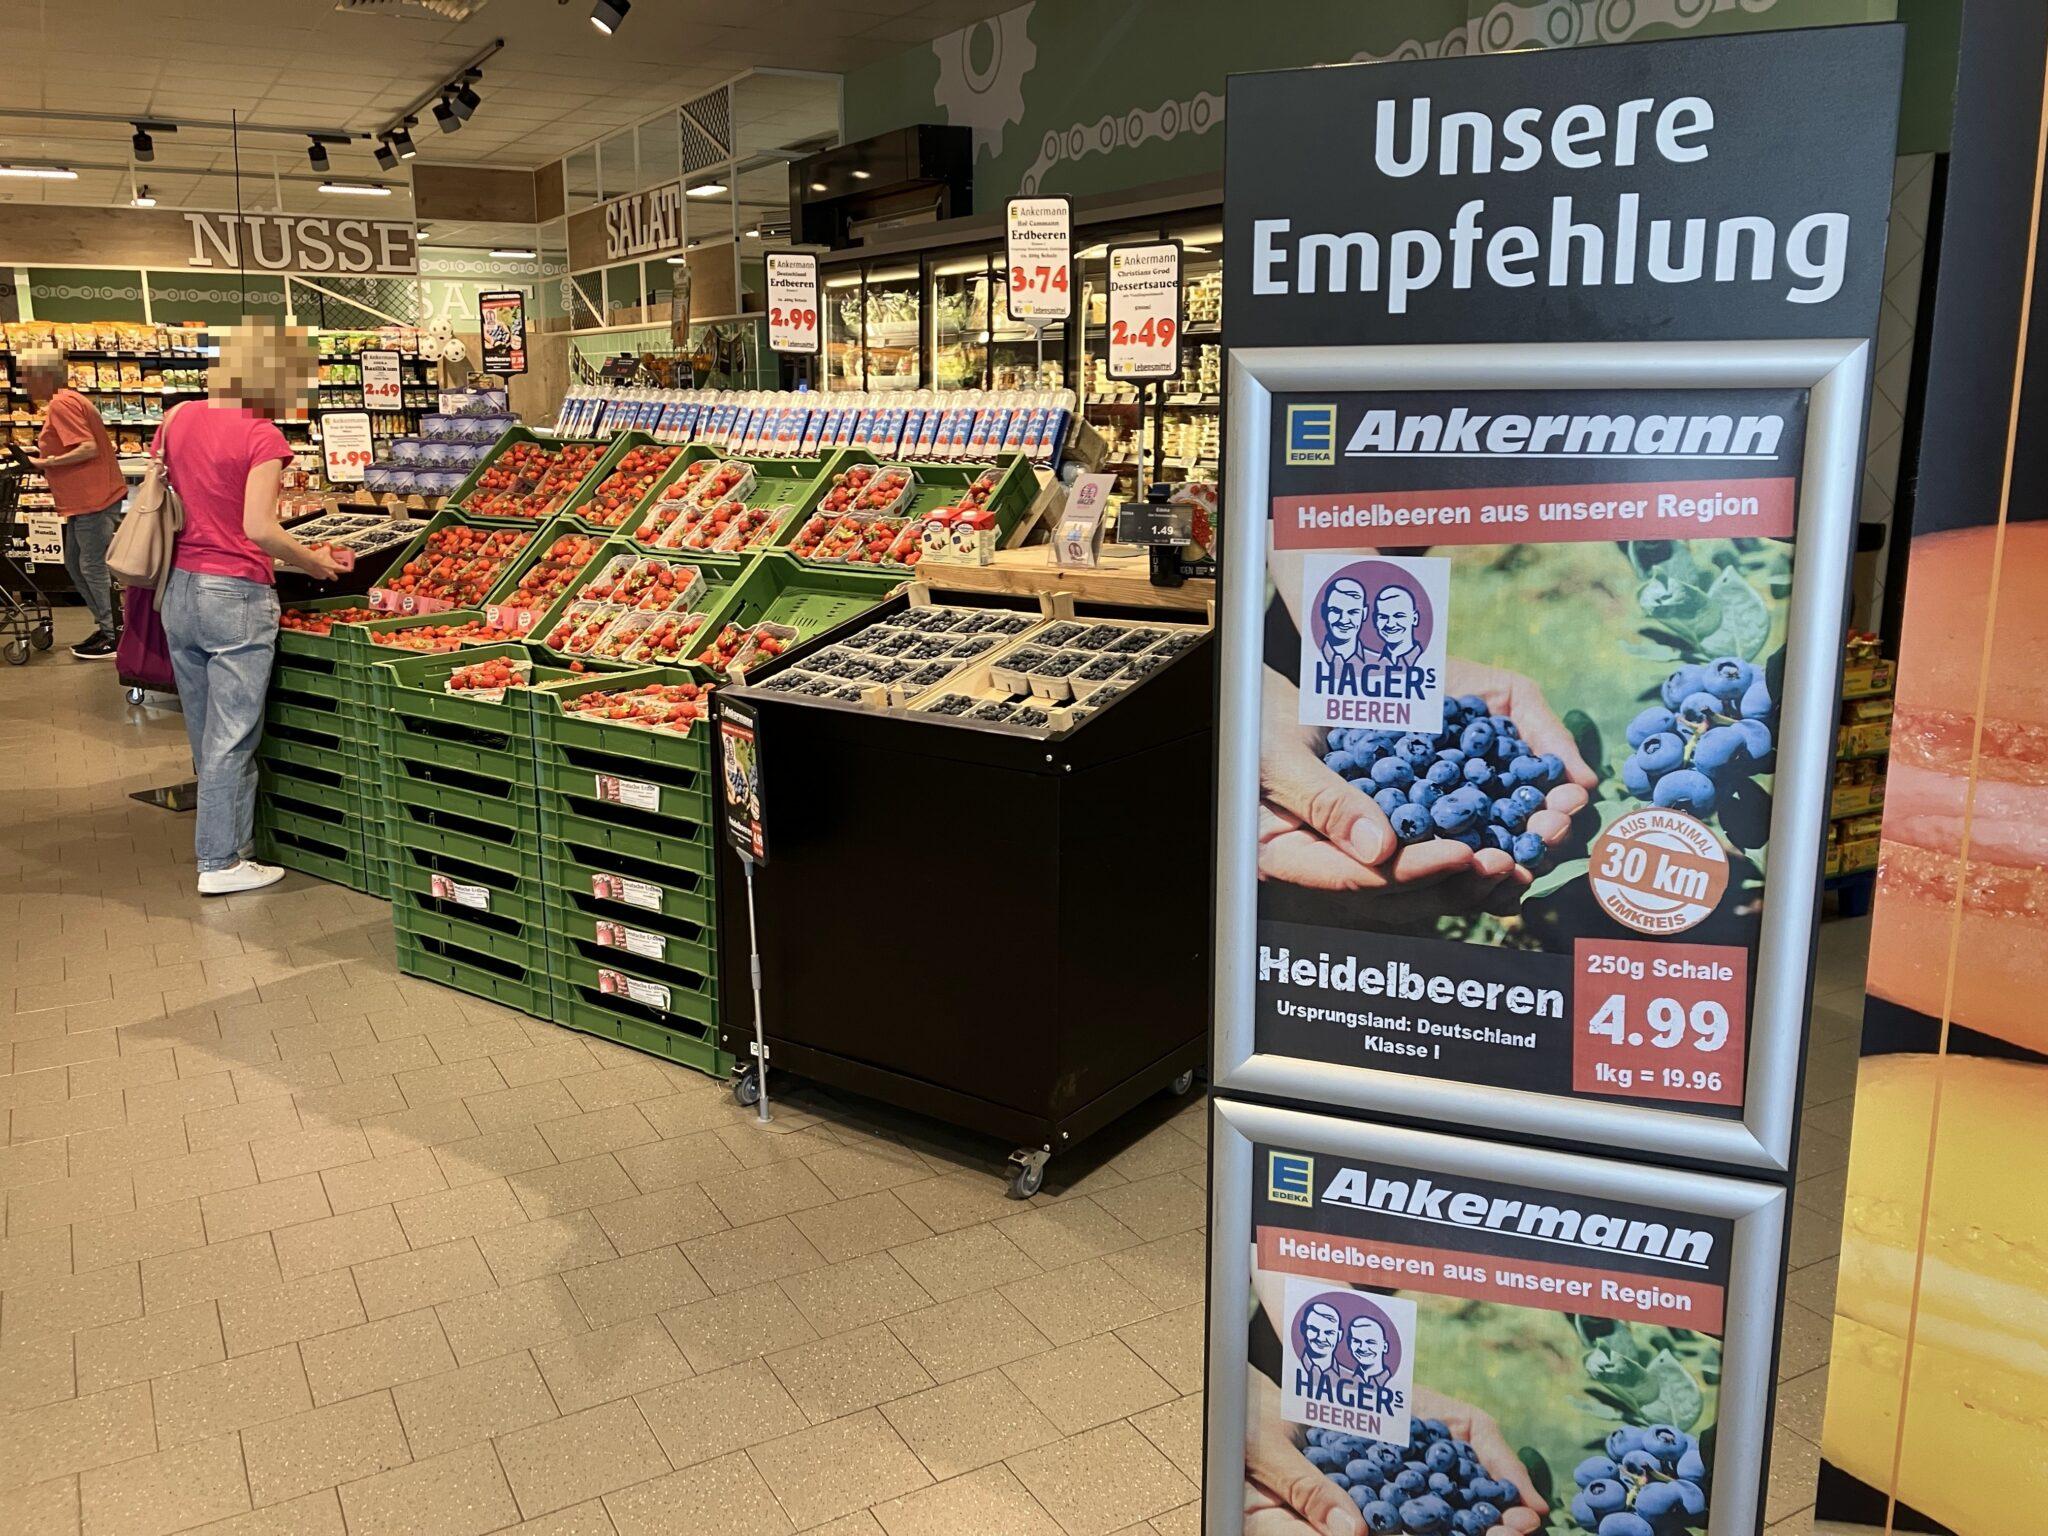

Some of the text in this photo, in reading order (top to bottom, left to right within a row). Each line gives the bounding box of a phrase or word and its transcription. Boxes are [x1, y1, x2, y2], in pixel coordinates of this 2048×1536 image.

[1374, 96, 1715, 178] Unsere
[605, 184, 680, 259] SALAT
[1020, 206, 1067, 216] Ankermann
[1012, 230, 1066, 240] Erdbeeren
[777, 260, 815, 269] Ankermann
[1124, 254, 1176, 266] Ankermann
[1252, 192, 1850, 314] Empfehlung
[770, 278, 815, 289] Erdbeeren
[1011, 265, 1068, 293] 3.74
[1111, 280, 1179, 292] Dessertsauce
[771, 308, 816, 331] 2.99
[1112, 317, 1176, 348] 2.49
[365, 383, 400, 397] 2.49
[1345, 408, 1785, 454] Ankermann
[329, 451, 372, 467] 1.99
[1290, 452, 1331, 461] EDEKA
[1298, 482, 1759, 529] Heidelbeeren aus unserer Region
[1151, 525, 1174, 535] 1.49
[32, 544, 62, 554] 3,49
[1326, 698, 1411, 725] BEEREN
[1620, 815, 1714, 857] AUS MAXIMAL
[1601, 842, 1710, 901] 30 km
[1606, 893, 1687, 929] UMKREIS
[1259, 945, 1565, 1020] Heidelbeeren
[1587, 954, 1734, 983] 250g Schale
[1276, 1000, 1537, 1050] Ursprungsland: Deutschland
[1588, 994, 1731, 1053] 4.99
[1364, 1035, 1429, 1059] Klasse
[1595, 1062, 1633, 1092] 1kg
[1662, 1067, 1723, 1093] 19.96
[1272, 1190, 1310, 1204] EDEKA
[1321, 1166, 1715, 1265] Ankermann
[1279, 1236, 1693, 1313] Heidelbeeren aus unserer Region
[1304, 1400, 1382, 1436] BEEREN
